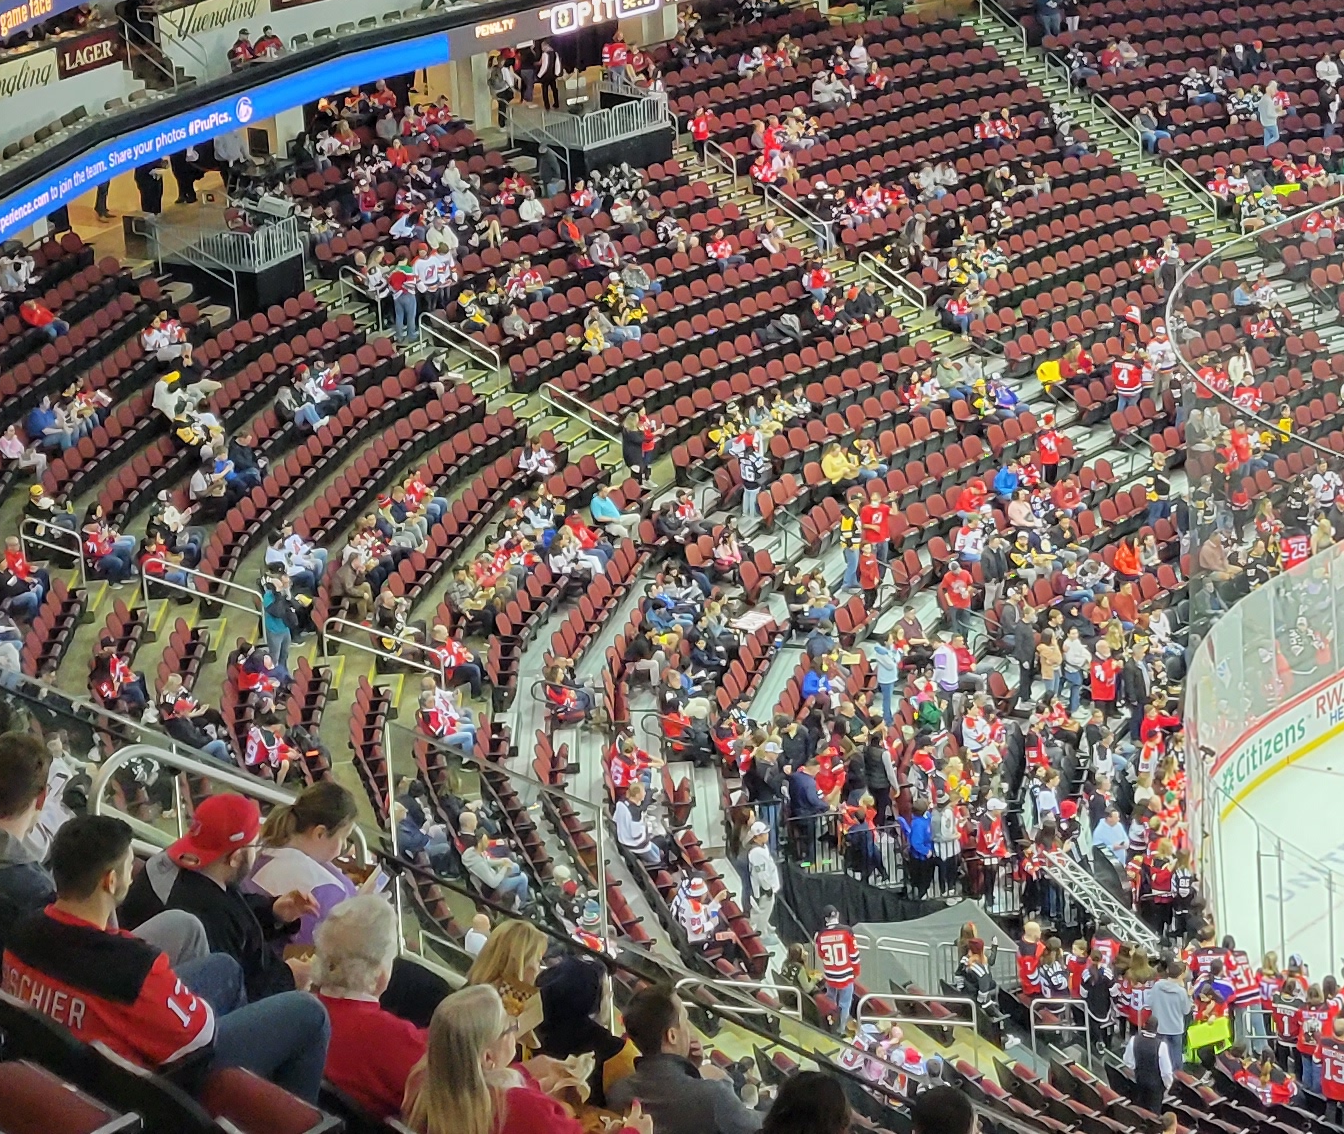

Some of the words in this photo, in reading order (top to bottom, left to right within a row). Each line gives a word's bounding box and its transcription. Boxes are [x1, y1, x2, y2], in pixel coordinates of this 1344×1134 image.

[0, 6, 28, 37] game
[475, 19, 514, 38] PENALTY
[64, 40, 113, 71] LAGER
[50, 186, 58, 200] to
[59, 176, 73, 199] join
[73, 167, 85, 186] the
[86, 159, 108, 182] team.
[109, 146, 132, 168] Share
[133, 139, 153, 164] your
[155, 127, 186, 151] photos
[188, 112, 232, 136] #PruPics.
[1236, 717, 1306, 783] Citizens
[820, 943, 847, 966] 30
[166, 977, 199, 1028] 13
[1282, 1016, 1289, 1037] 1
